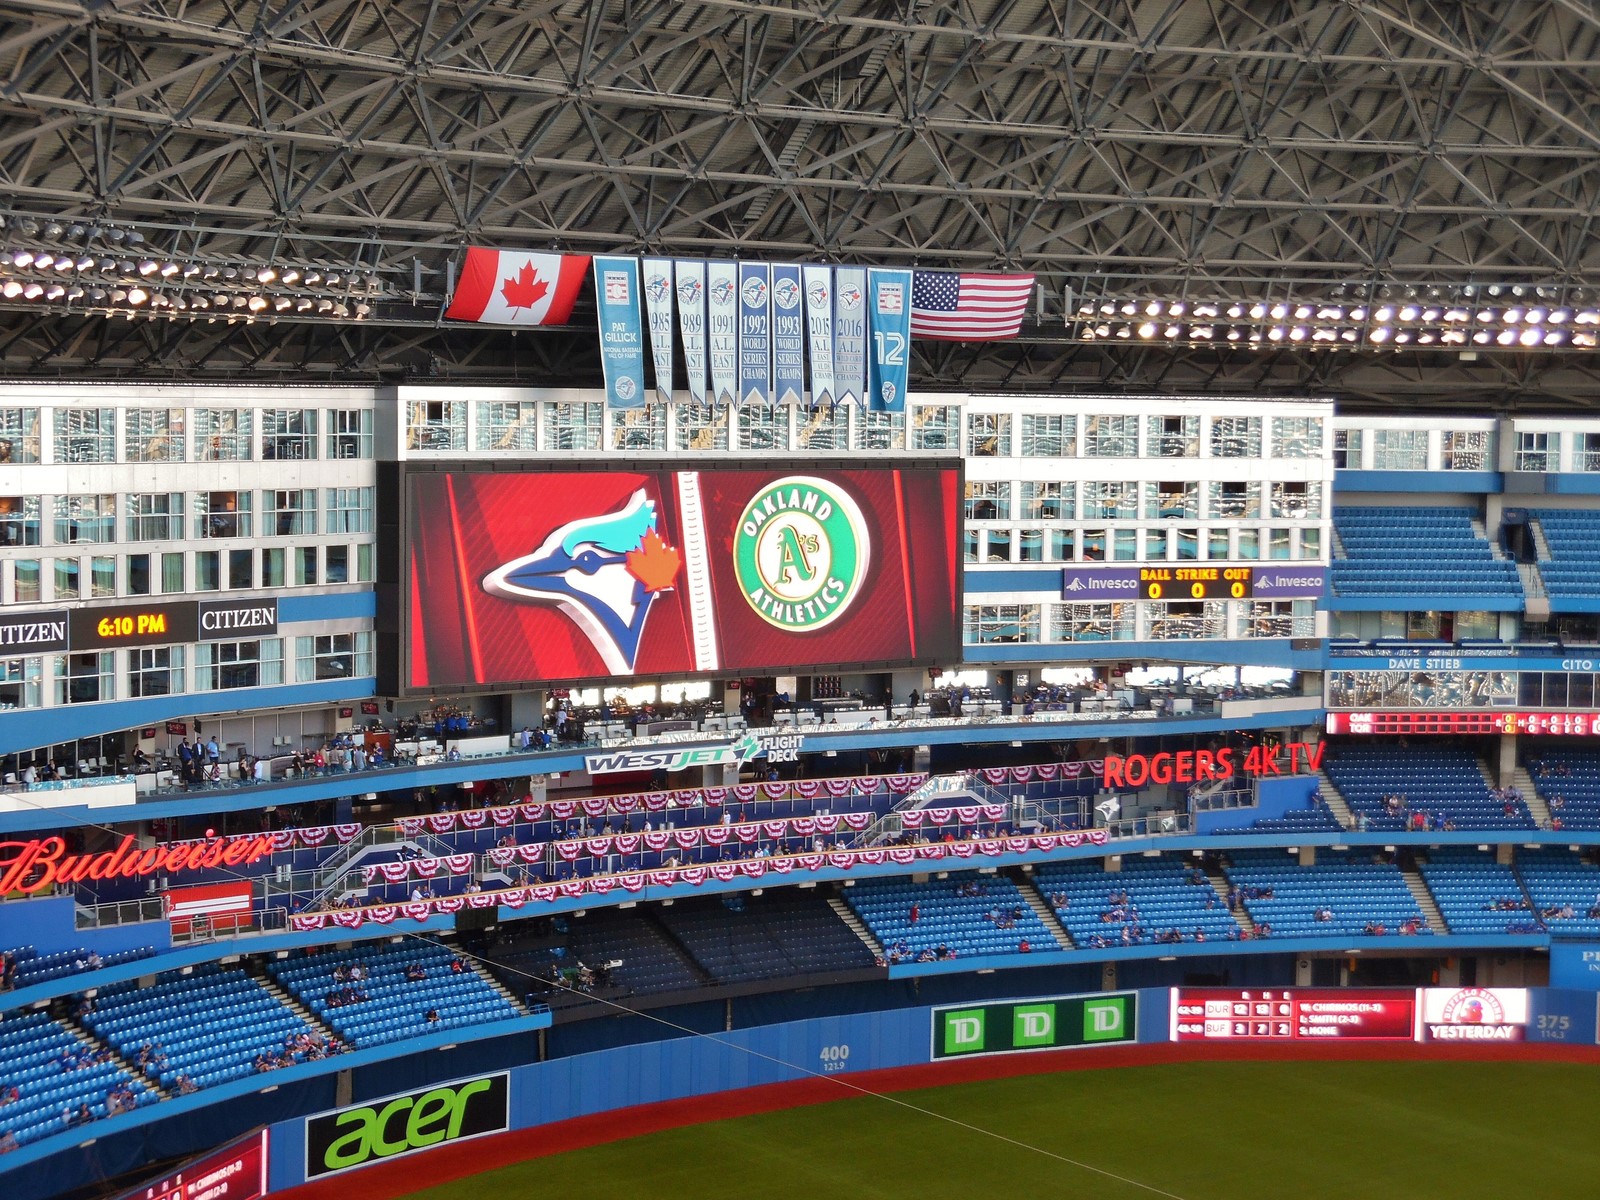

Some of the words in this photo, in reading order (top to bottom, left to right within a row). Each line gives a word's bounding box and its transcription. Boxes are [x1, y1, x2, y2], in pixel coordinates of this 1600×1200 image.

[612, 322, 626, 332] PAT
[650, 312, 670, 332] 985
[681, 313, 702, 333] 989
[712, 314, 734, 333] 1991
[742, 315, 766, 334] 1992
[777, 316, 800, 335] 1993
[837, 319, 862, 337] 2016
[604, 332, 637, 343] GILLICK
[653, 335, 670, 348] .L.
[684, 337, 702, 350] .L.
[712, 337, 734, 350] A.L.
[742, 338, 767, 350] WORLD
[777, 338, 801, 350] WORLD
[839, 341, 860, 353] A.L.
[874, 331, 905, 365] 12
[655, 353, 670, 366] AST
[713, 354, 734, 368] EAST
[743, 353, 767, 365] SERIES
[777, 353, 801, 365] SERIES
[742, 368, 767, 380] CHAMPS
[777, 368, 802, 380] CHAMPS
[743, 488, 832, 537] OAKLAND
[1140, 568, 1171, 581] BALL
[1175, 568, 1218, 580] STRIKE
[1224, 568, 1250, 580] OUT
[1088, 577, 1138, 590] Invesco
[1275, 575, 1323, 588] Invesco
[1148, 583, 1161, 598] 0
[1191, 582, 1204, 598] 0
[1231, 582, 1244, 598] 0
[750, 577, 844, 622] ATHLETICS
[201, 607, 276, 630] CITIZEN
[97, 617, 133, 637] 6:10
[138, 614, 165, 634] PM
[1388, 658, 1420, 669] DAVE
[1426, 658, 1460, 669] STIEB
[1561, 659, 1593, 670] CITO
[1349, 713, 1371, 722] OAK
[1349, 723, 1371, 732] TOR
[763, 735, 805, 750] FLIGHT
[589, 748, 730, 771] WESTJET
[768, 749, 798, 763] DECK
[1103, 748, 1233, 788] ROGERS
[1243, 744, 1281, 776] 4K
[1285, 739, 1327, 773] TV
[0, 828, 276, 895] Budweiser
[1242, 991, 1250, 1000] R
[1262, 991, 1271, 1000] H
[1283, 991, 1290, 1000] E
[1207, 1005, 1229, 1013] DUR
[1359, 1003, 1382, 1012] (11-3)
[1444, 988, 1476, 1019] BUFFALO
[1479, 990, 1503, 1019] BISONS
[949, 1017, 980, 1043] TD
[1018, 1012, 1050, 1037] TD
[1088, 1006, 1120, 1031] TD
[1309, 1015, 1337, 1023] SMITH
[1338, 1015, 1360, 1024] (2-3)
[1537, 1015, 1570, 1030] 375
[1206, 1024, 1225, 1033] BUF
[1235, 1023, 1245, 1034] 3
[1257, 1023, 1267, 1034] 7
[1279, 1023, 1289, 1034] 2
[1430, 1025, 1514, 1039] YESTERDAY
[820, 1044, 850, 1061] 400
[324, 1079, 491, 1169] acer
